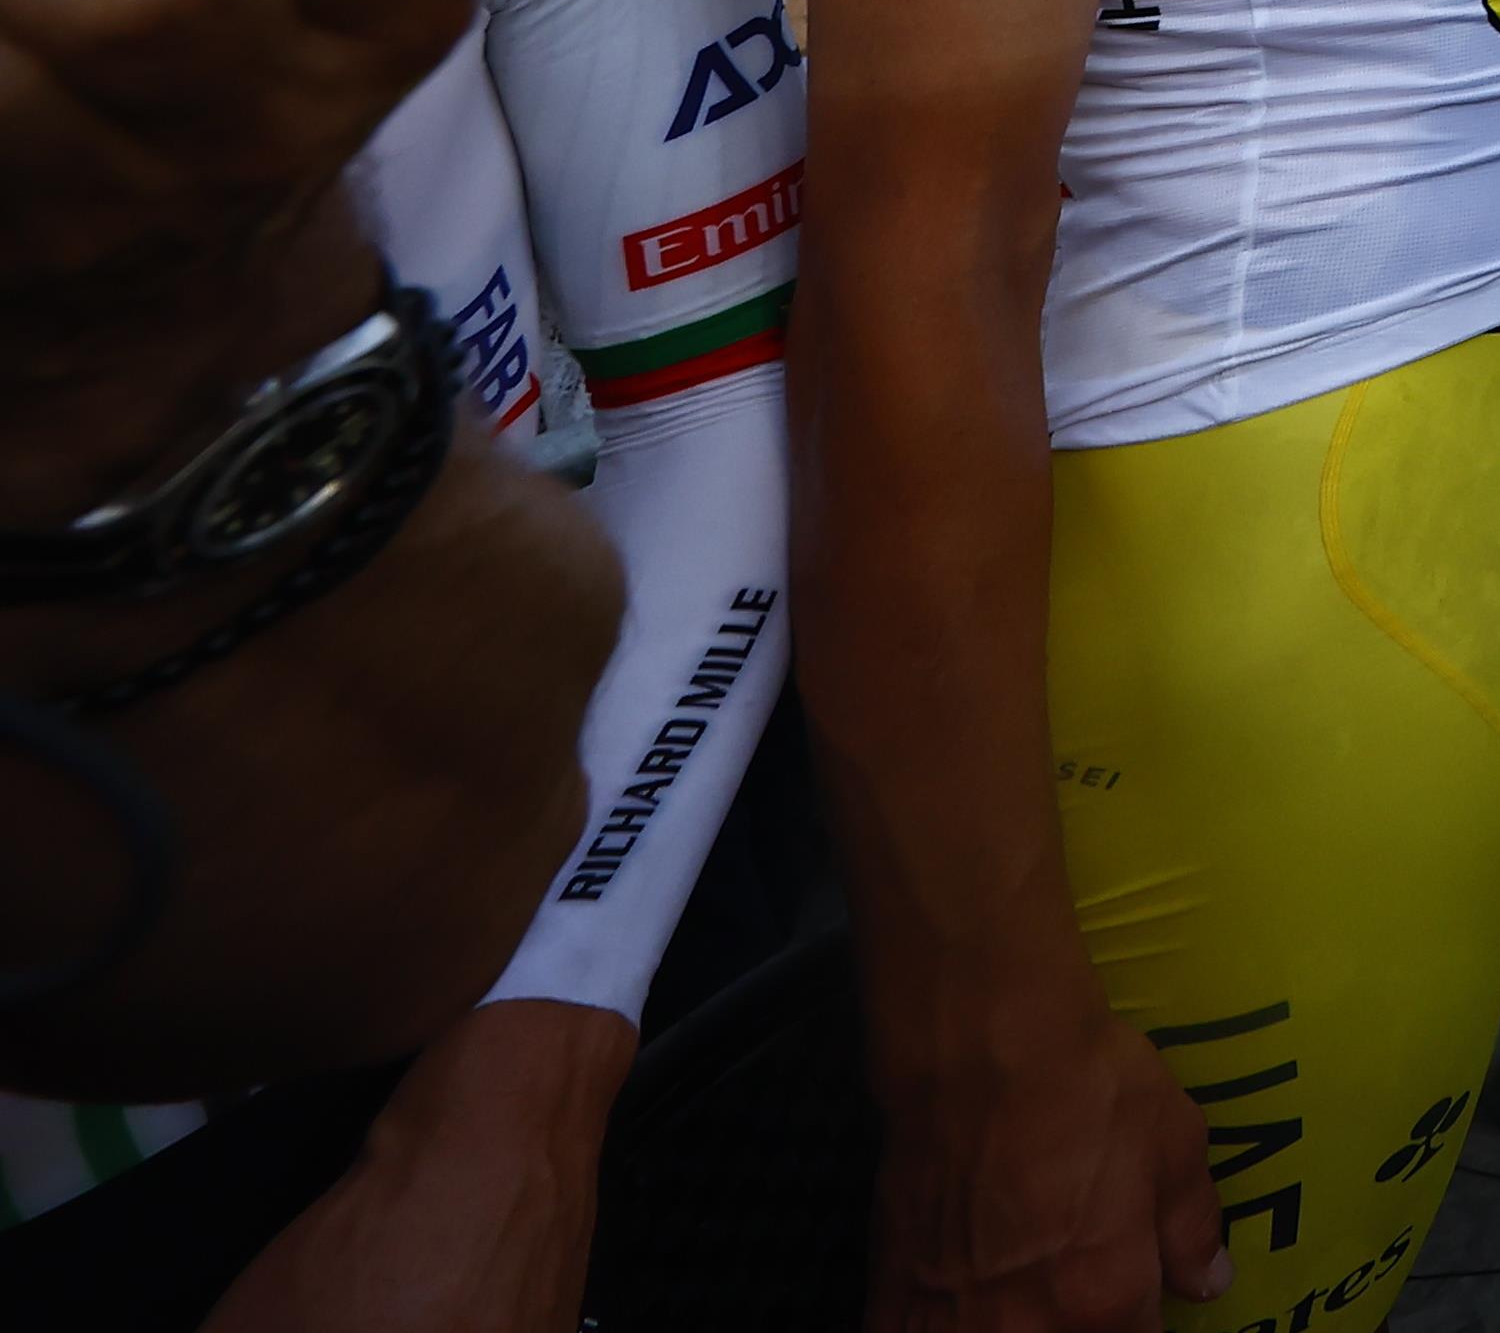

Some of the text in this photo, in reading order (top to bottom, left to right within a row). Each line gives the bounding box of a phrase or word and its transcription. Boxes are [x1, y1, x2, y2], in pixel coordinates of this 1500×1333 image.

[451, 264, 529, 416] FAB
[558, 585, 779, 903] RICHARD MILLE
[1056, 760, 1121, 791] SEI
